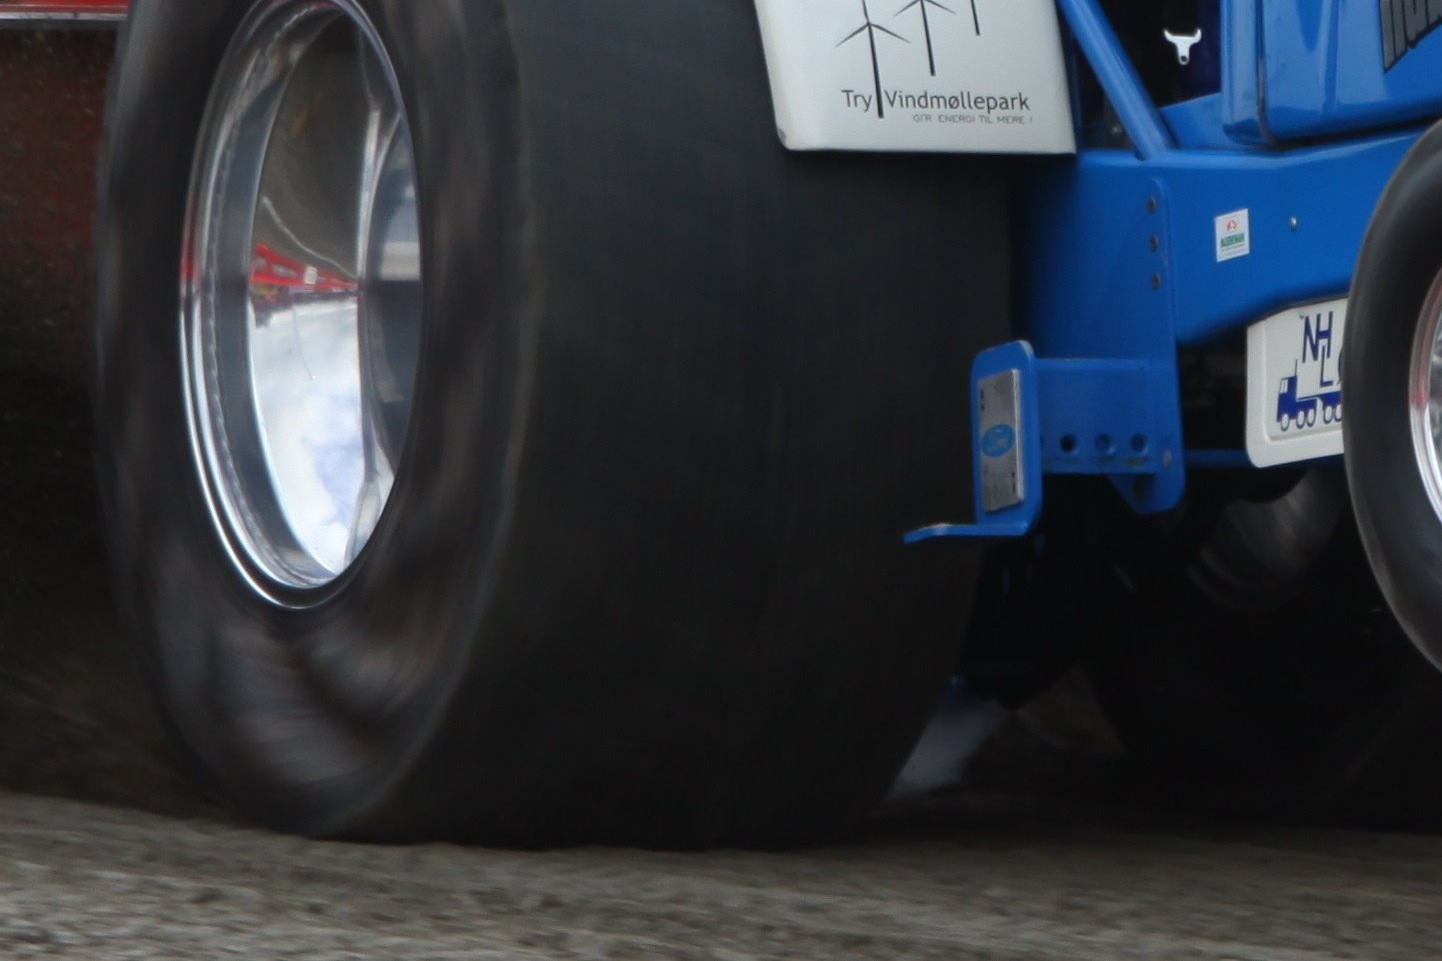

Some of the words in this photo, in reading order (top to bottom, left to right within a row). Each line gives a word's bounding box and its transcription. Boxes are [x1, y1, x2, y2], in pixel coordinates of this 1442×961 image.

[841, 89, 873, 113] Try
[884, 89, 1031, 115] Vindmøllepark
[979, 115, 993, 125] TIL
[1302, 311, 1333, 364] NH
